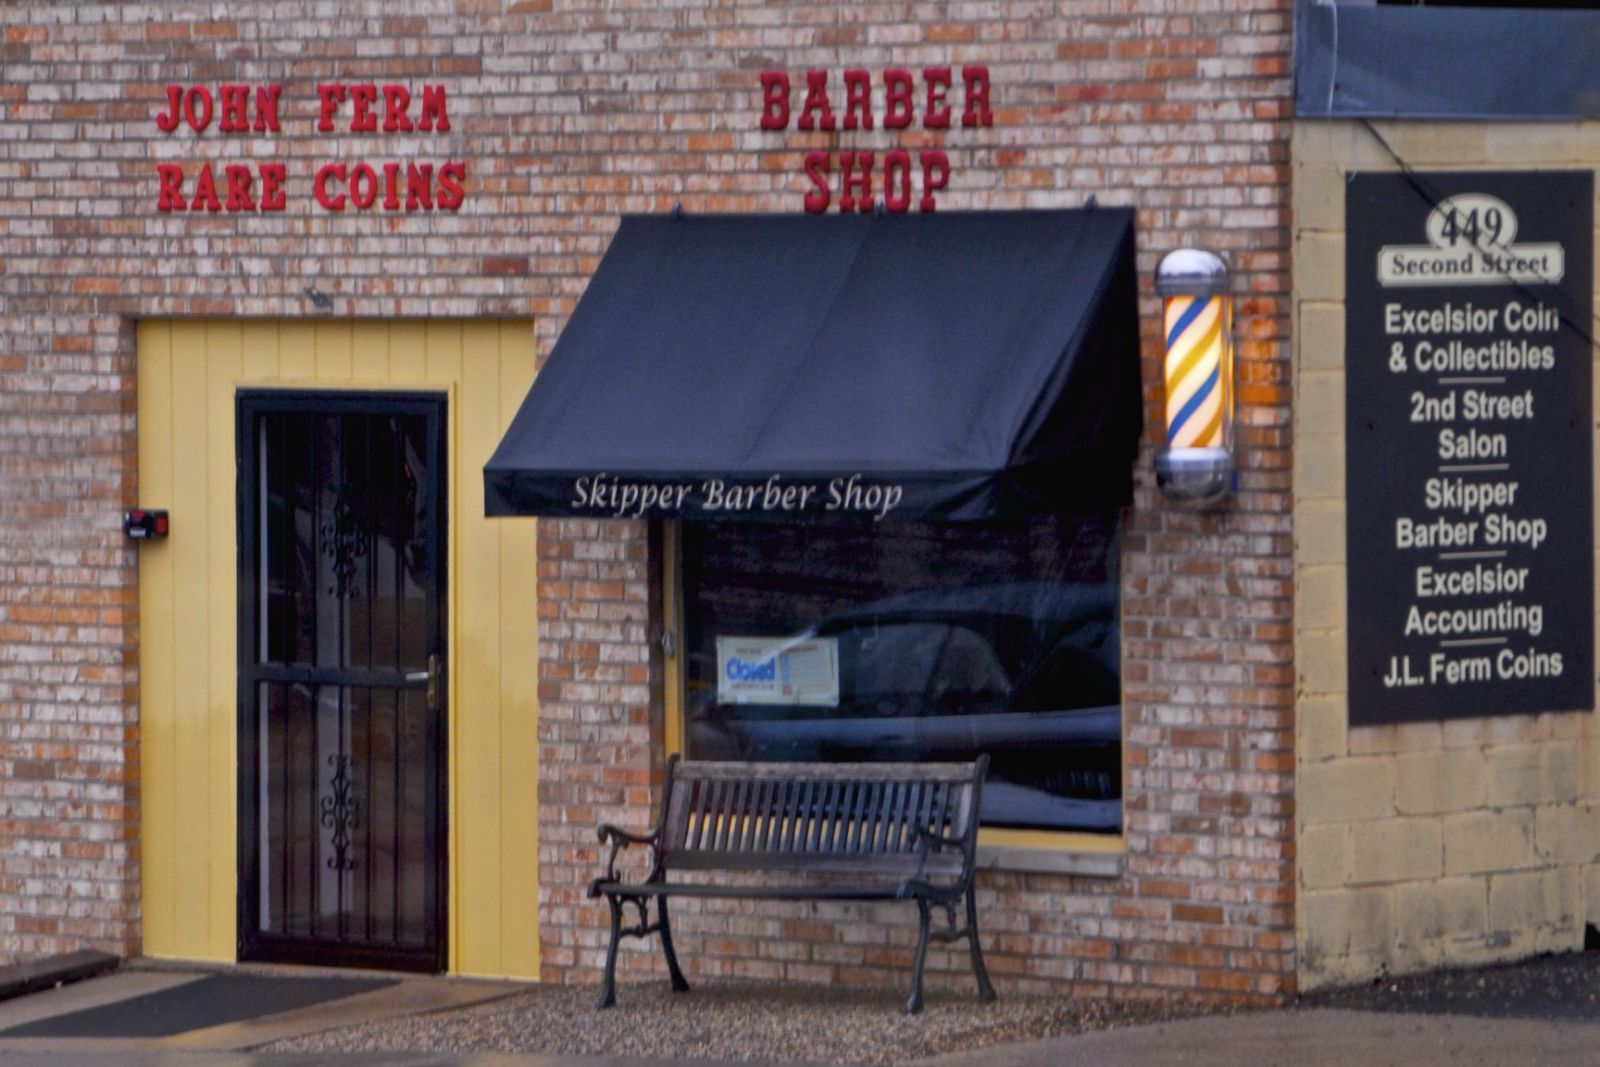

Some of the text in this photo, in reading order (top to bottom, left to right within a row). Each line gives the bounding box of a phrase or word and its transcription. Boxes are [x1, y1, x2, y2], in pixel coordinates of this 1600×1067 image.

[156, 84, 451, 132] JOHN FERM
[760, 65, 993, 131] BARBER
[156, 161, 466, 212] RARE COINS
[804, 149, 950, 214] SHOP
[1441, 206, 1503, 247] 449
[1392, 253, 1550, 276] Second Street
[1385, 301, 1559, 334] Excelsior Coin
[1388, 339, 1555, 373] & Collectibles
[1410, 389, 1534, 422] 2nd Street
[1438, 428, 1507, 460] Salon
[571, 472, 903, 522] Skipper Barber Shop
[1425, 478, 1519, 515] Skipper
[1396, 513, 1547, 551] Barber Shop
[1416, 563, 1529, 597] Excelsior
[1404, 601, 1543, 637] Accounting
[1383, 647, 1564, 688] J.L. Ferm Coins
